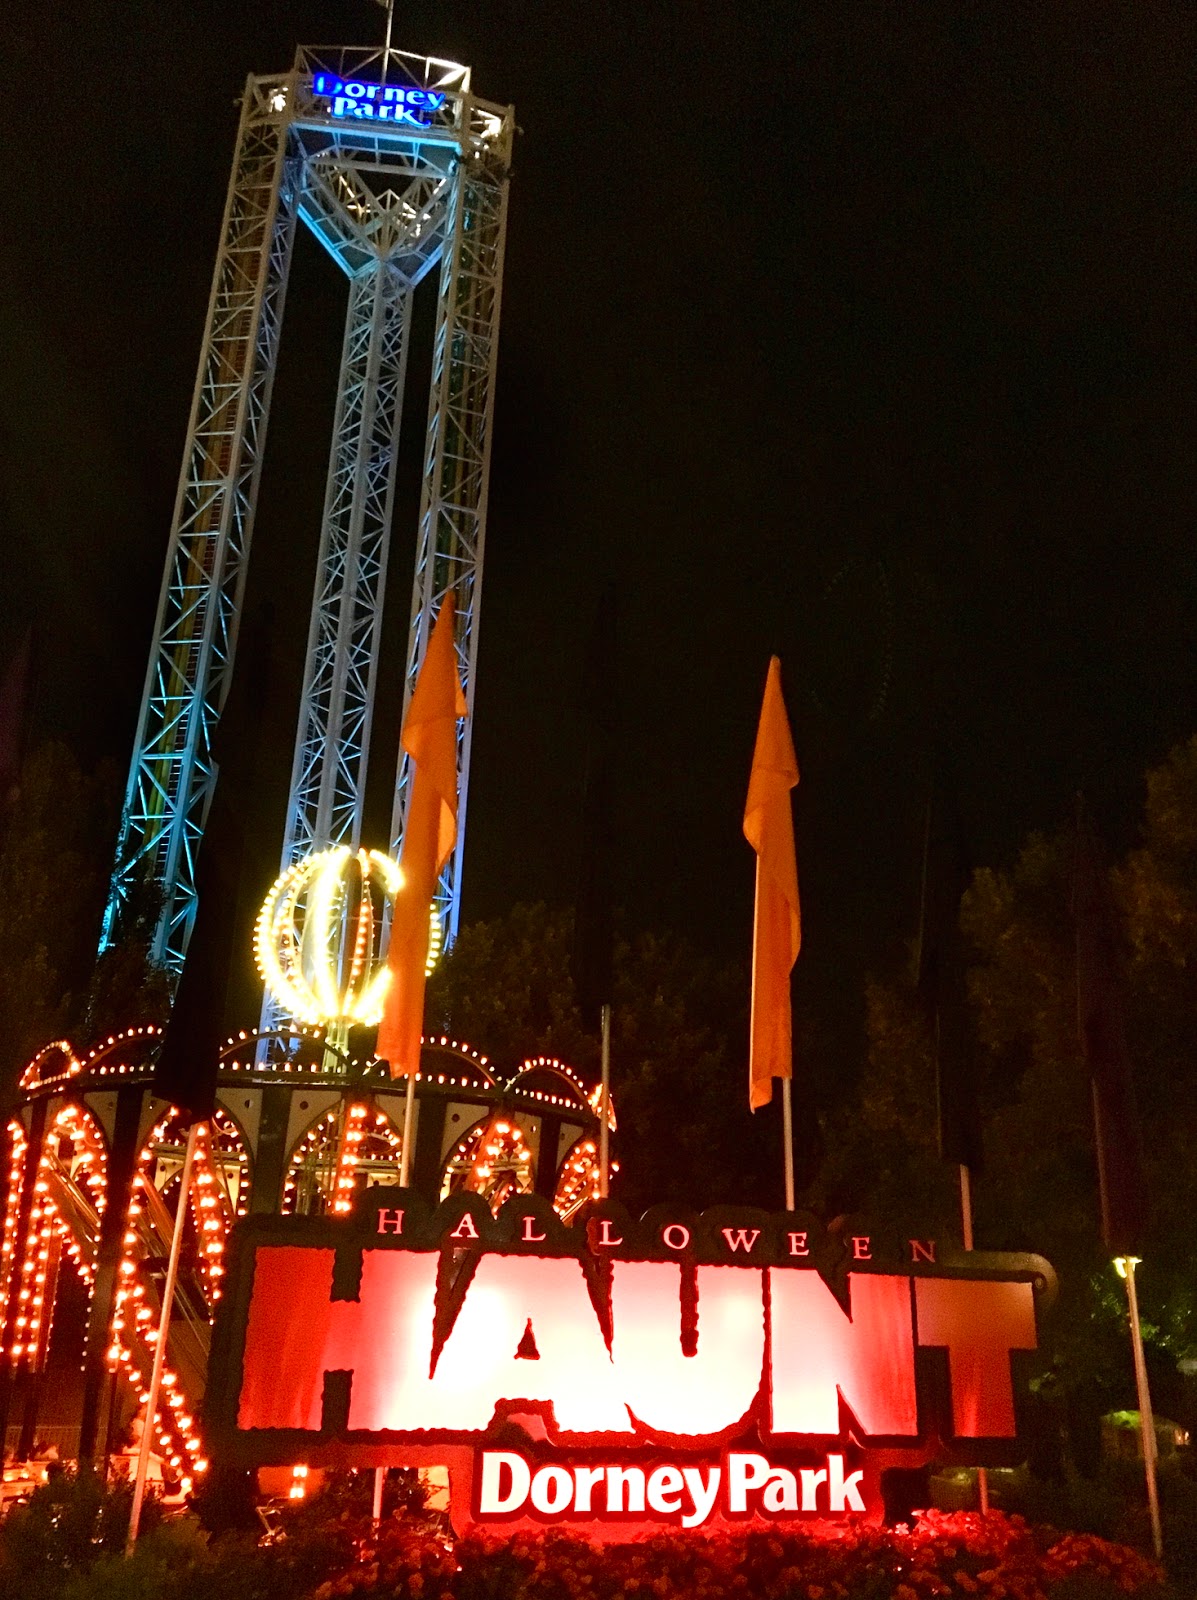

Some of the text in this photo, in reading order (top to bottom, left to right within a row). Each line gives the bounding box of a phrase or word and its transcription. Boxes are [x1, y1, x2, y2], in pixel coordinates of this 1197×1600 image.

[333, 97, 432, 128] Park
[376, 1208, 937, 1263] HALLOWEEN
[237, 1246, 1037, 1438] HAUNT
